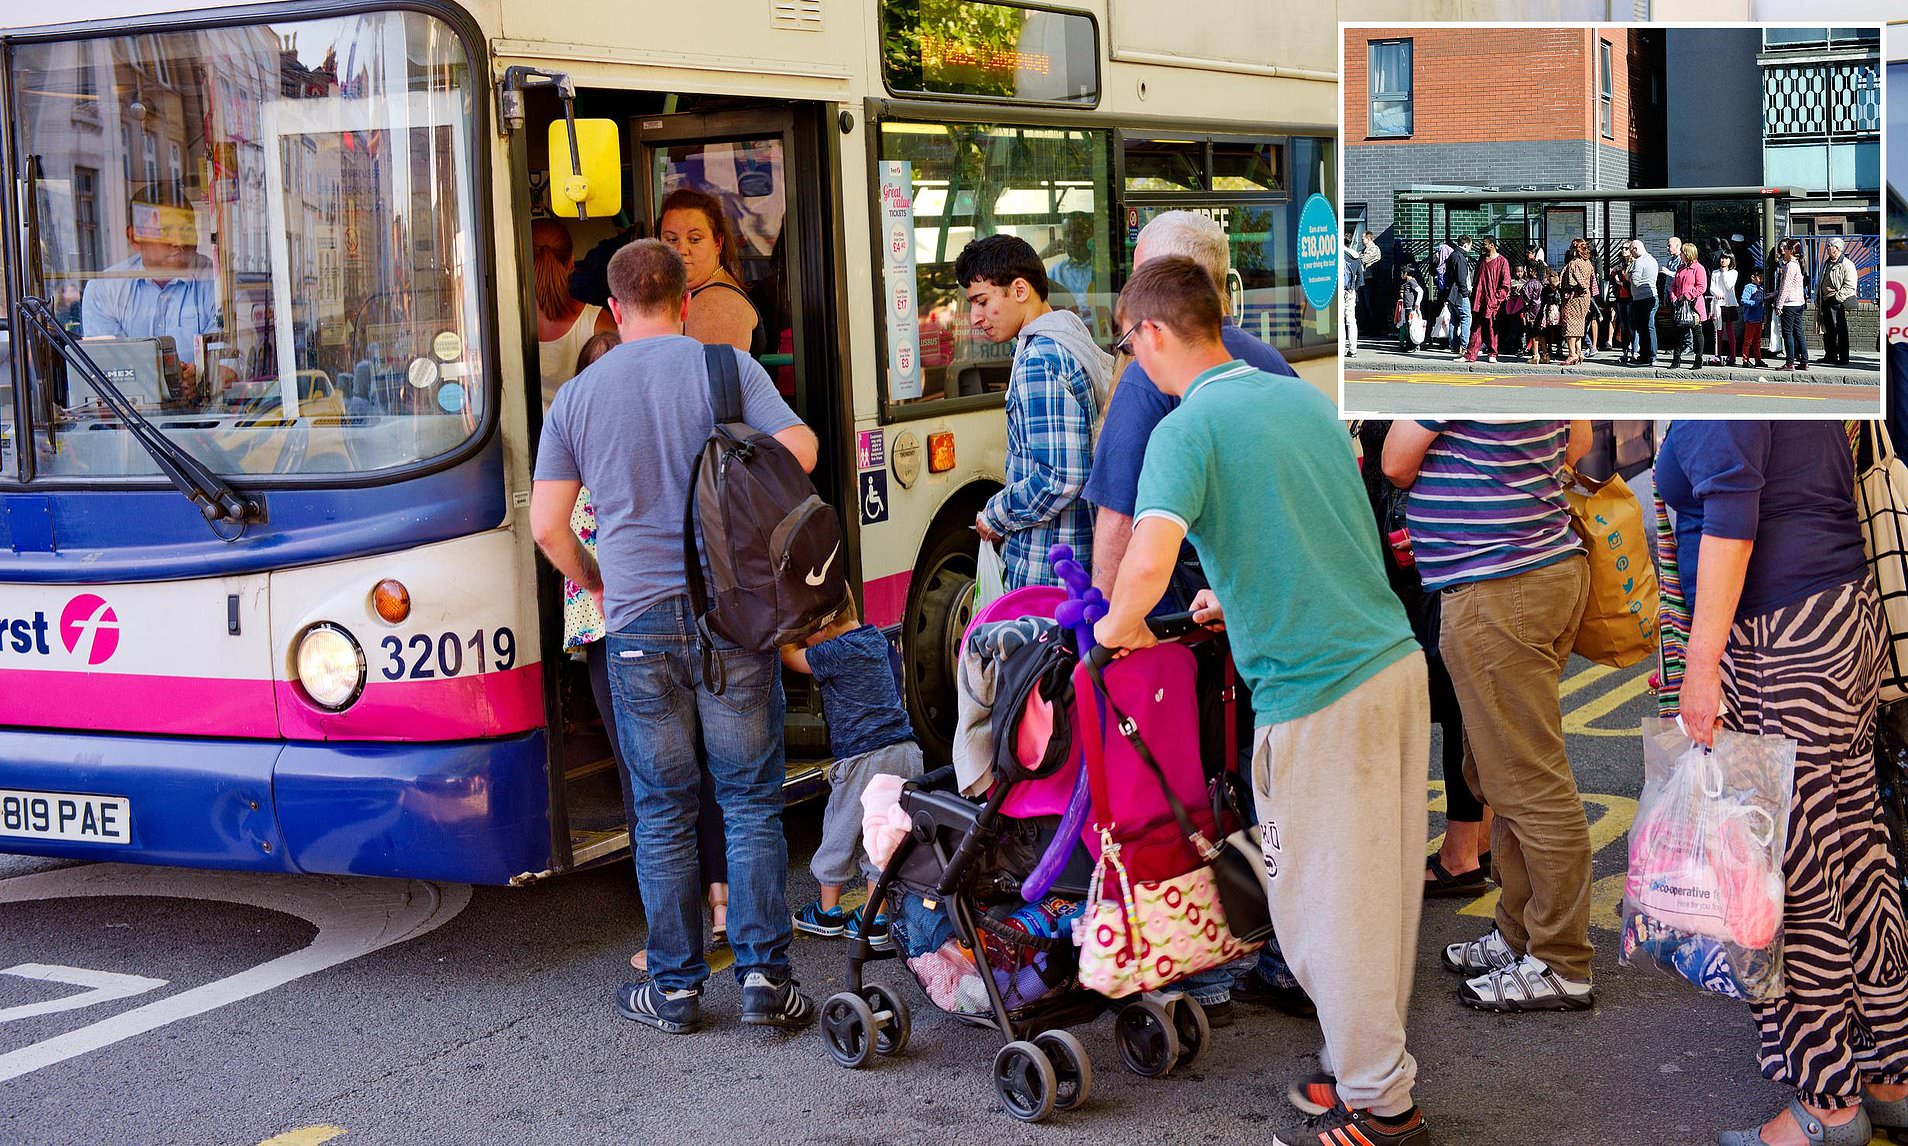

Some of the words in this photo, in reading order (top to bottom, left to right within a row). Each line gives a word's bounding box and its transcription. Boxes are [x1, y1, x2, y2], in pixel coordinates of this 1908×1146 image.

[883, 184, 901, 202] Great
[888, 209, 907, 218] TICKETS
[1301, 234, 1336, 260] £18,000
[896, 299, 906, 311] £17
[971, 328, 985, 336] mo
[901, 358, 910, 369] £3
[380, 626, 516, 681] 32019
[3, 796, 50, 832] 819
[58, 799, 120, 838] PAE
